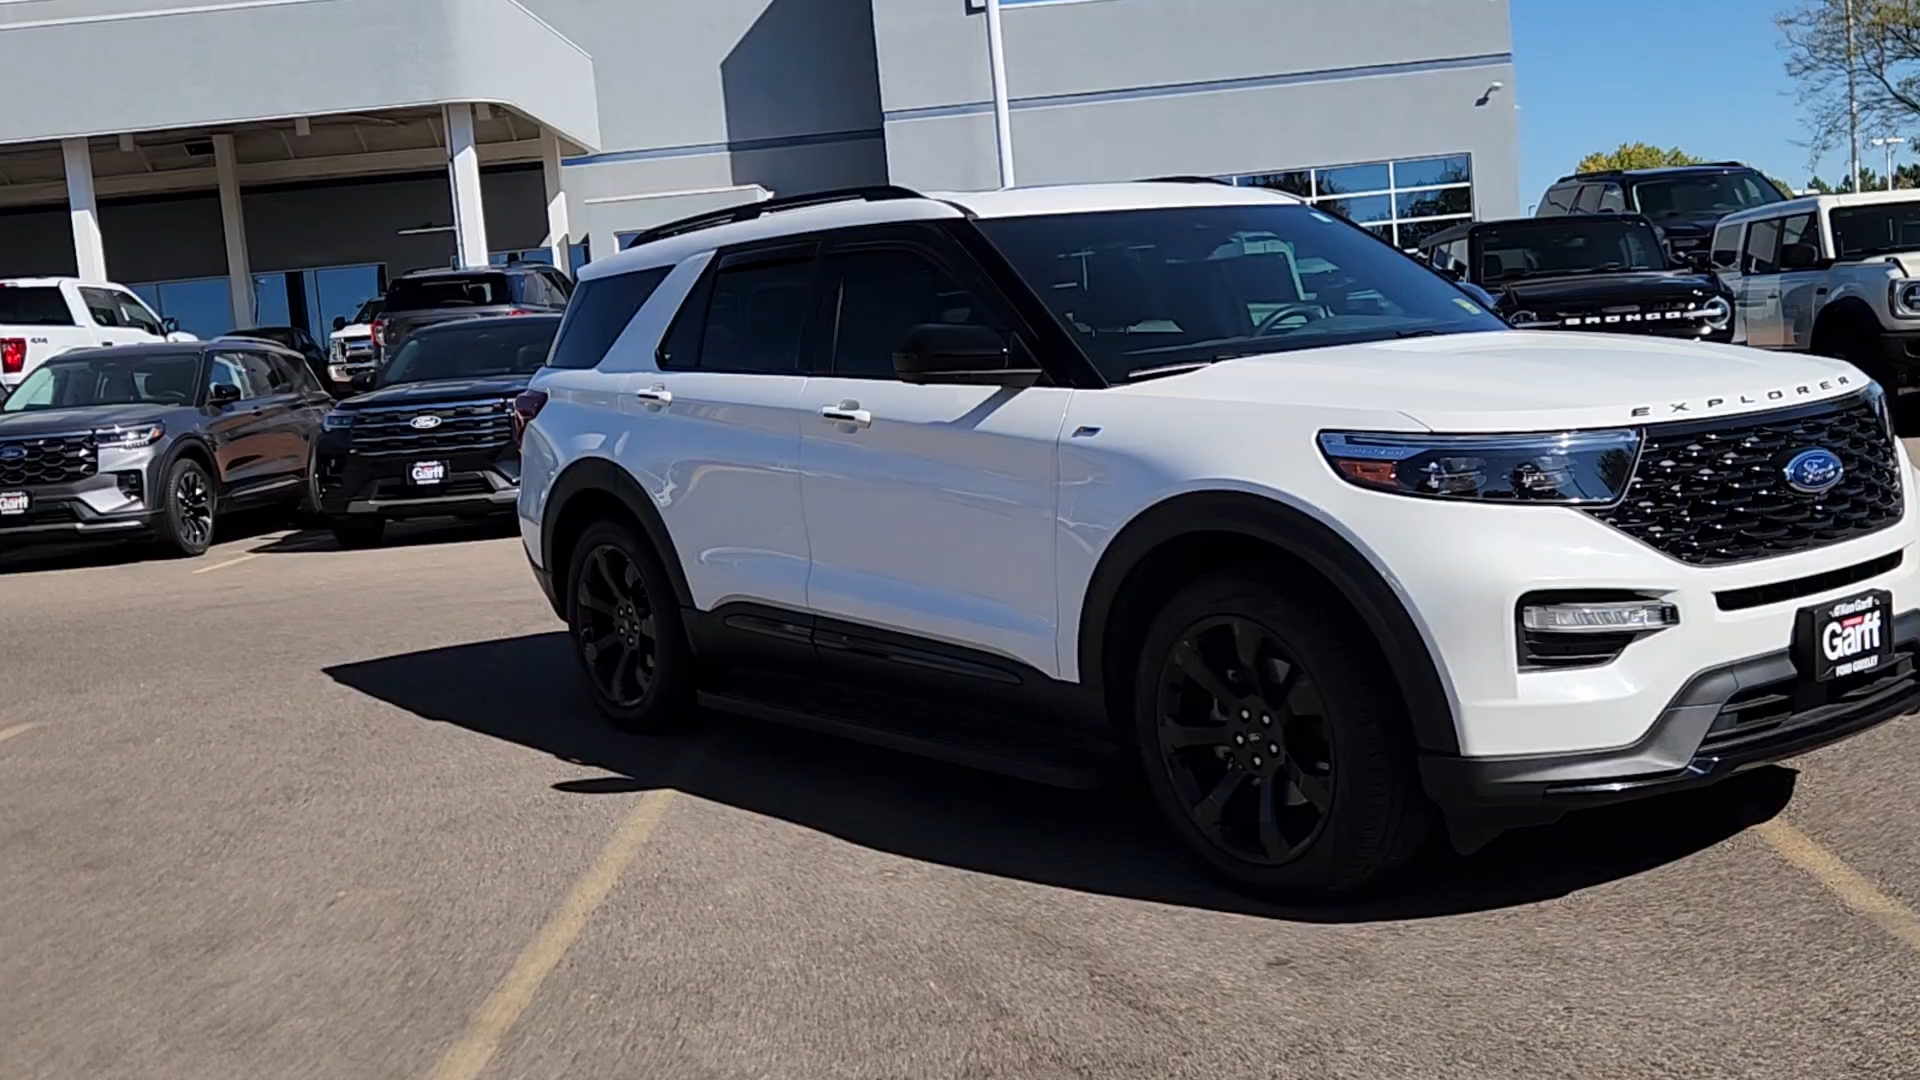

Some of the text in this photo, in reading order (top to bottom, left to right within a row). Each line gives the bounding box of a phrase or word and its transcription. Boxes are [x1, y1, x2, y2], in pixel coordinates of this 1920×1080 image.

[1565, 311, 1682, 326] BRONCO
[1631, 376, 1850, 417] EXPLORER
[412, 465, 444, 480] Garff
[1823, 610, 1881, 661] Garff
